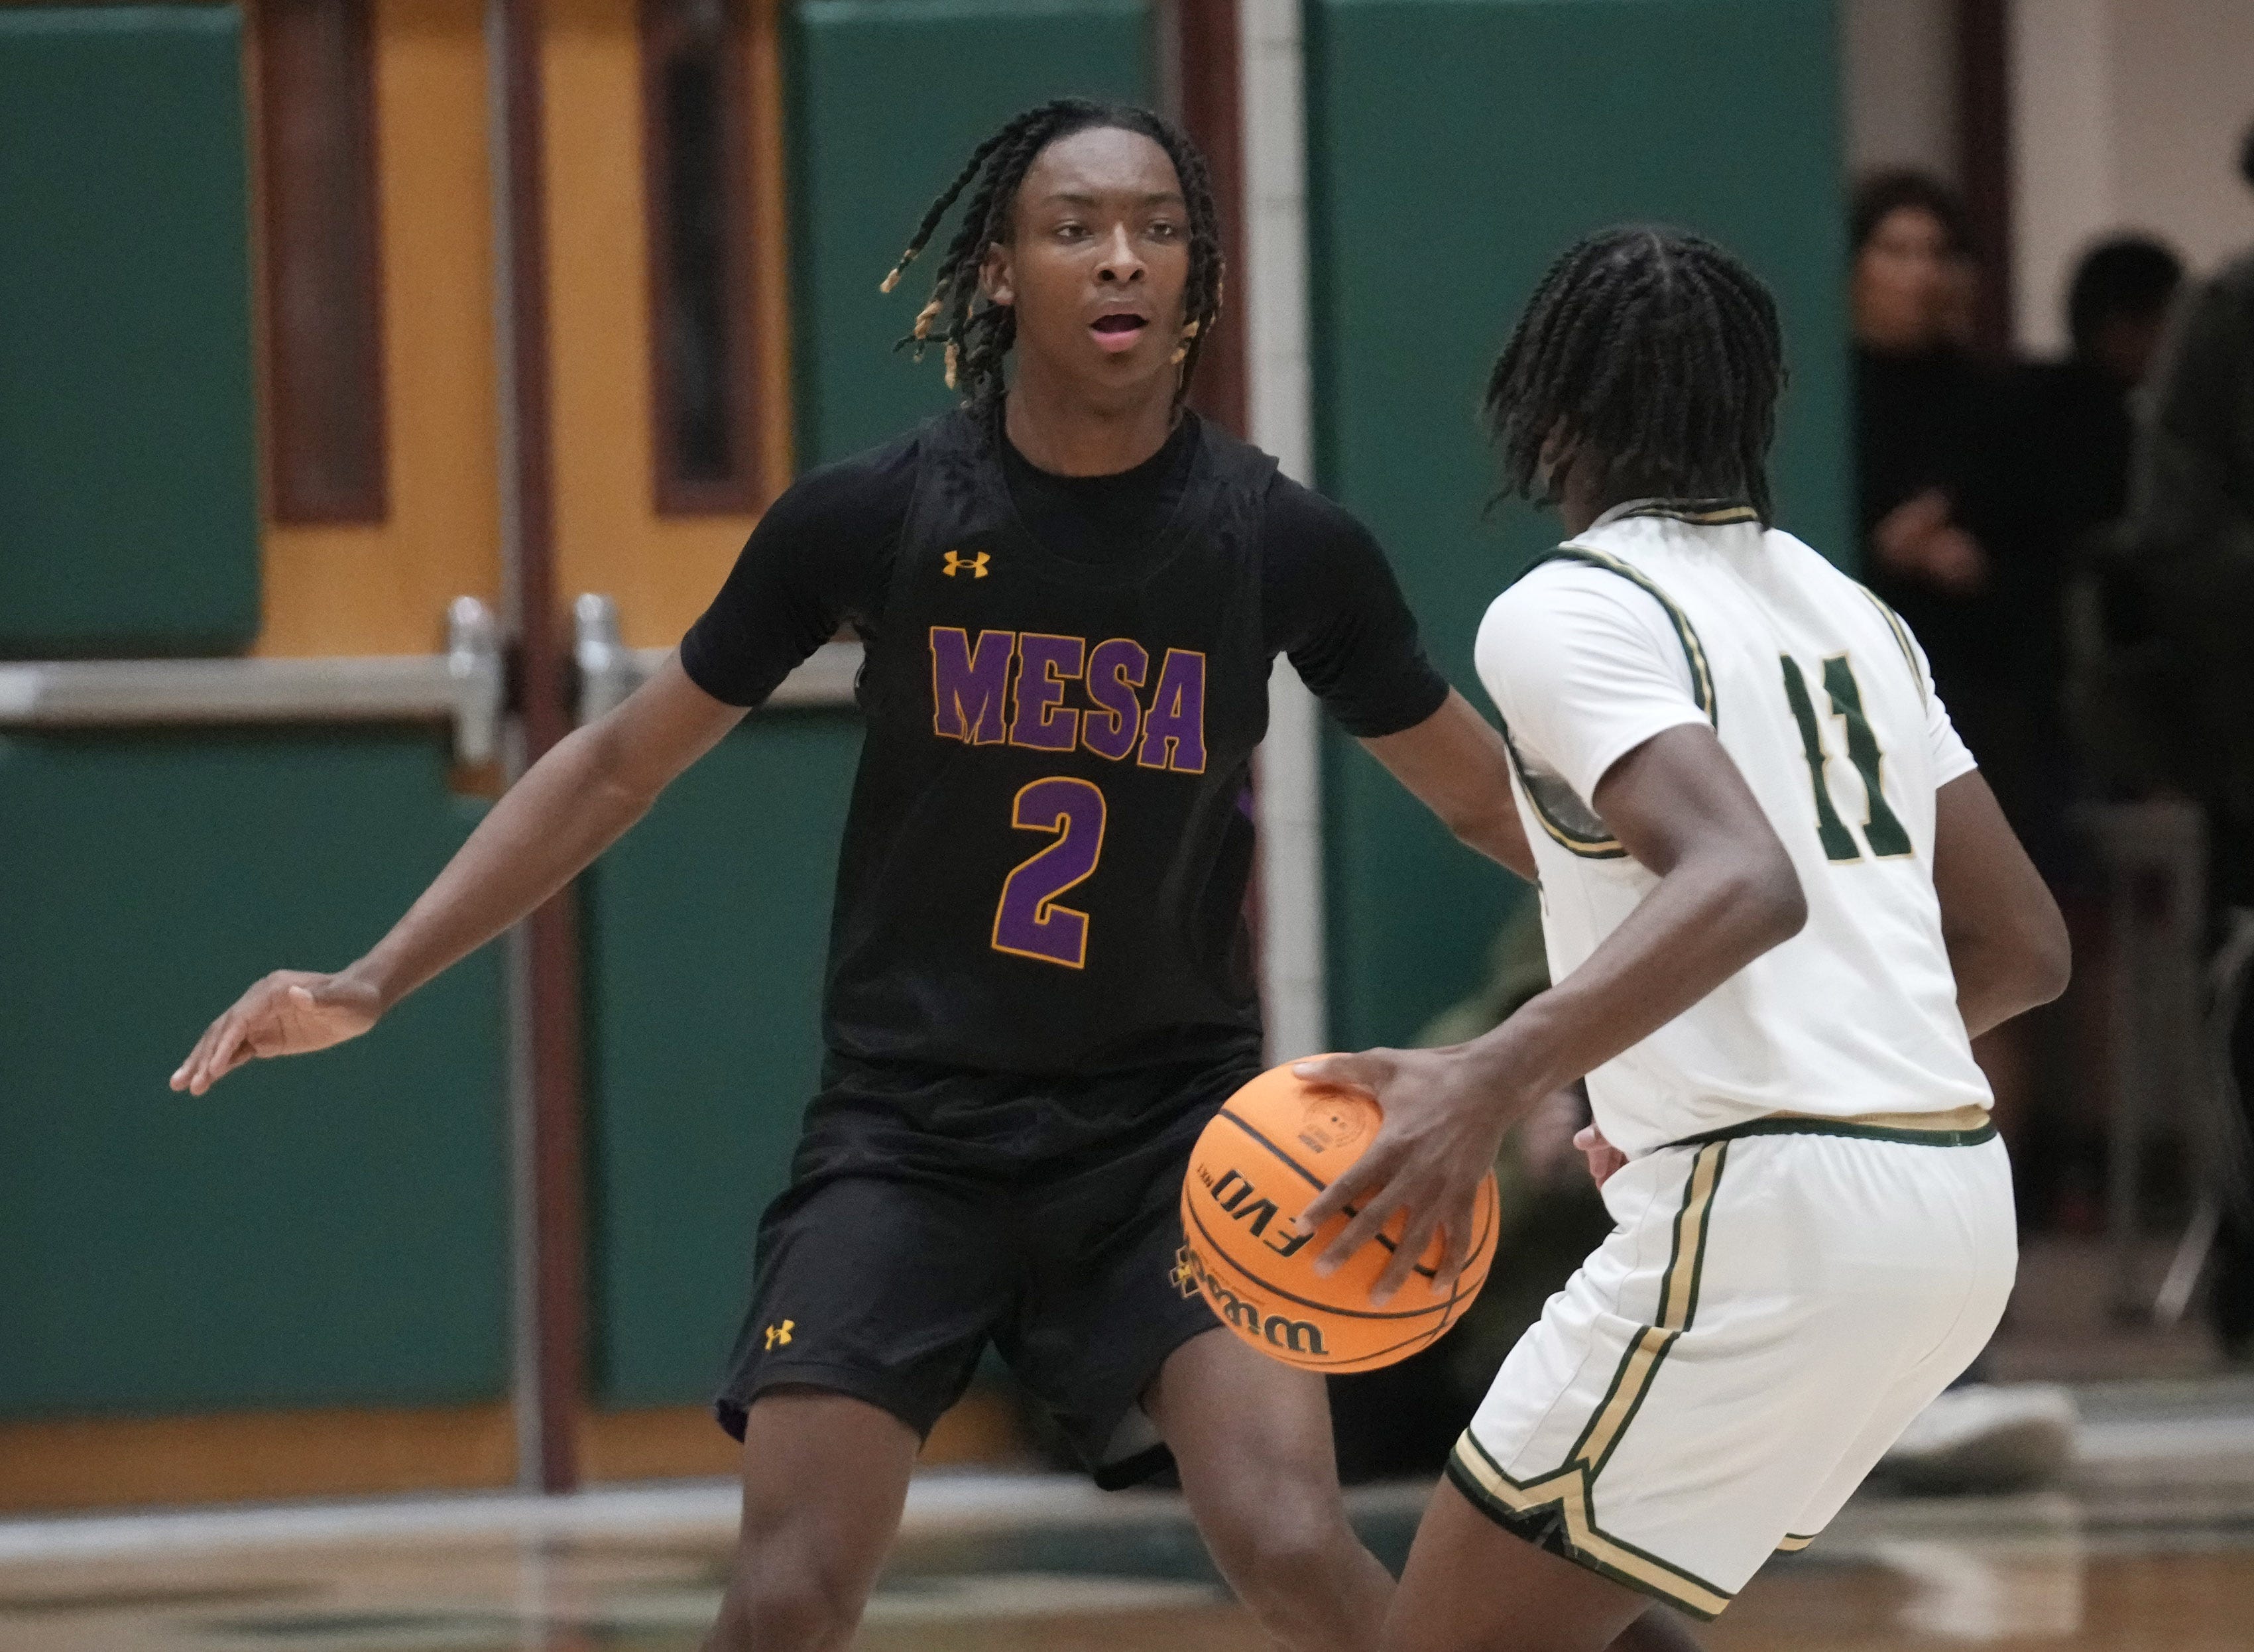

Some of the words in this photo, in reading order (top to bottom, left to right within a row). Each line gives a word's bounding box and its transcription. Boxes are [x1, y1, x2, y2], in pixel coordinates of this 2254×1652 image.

[929, 626, 1207, 774] MESA
[1779, 649, 1915, 866] 11
[992, 776, 1107, 969] 2
[1211, 1168, 1316, 1258] EVO
[1184, 1235, 1329, 1355] Wilso
